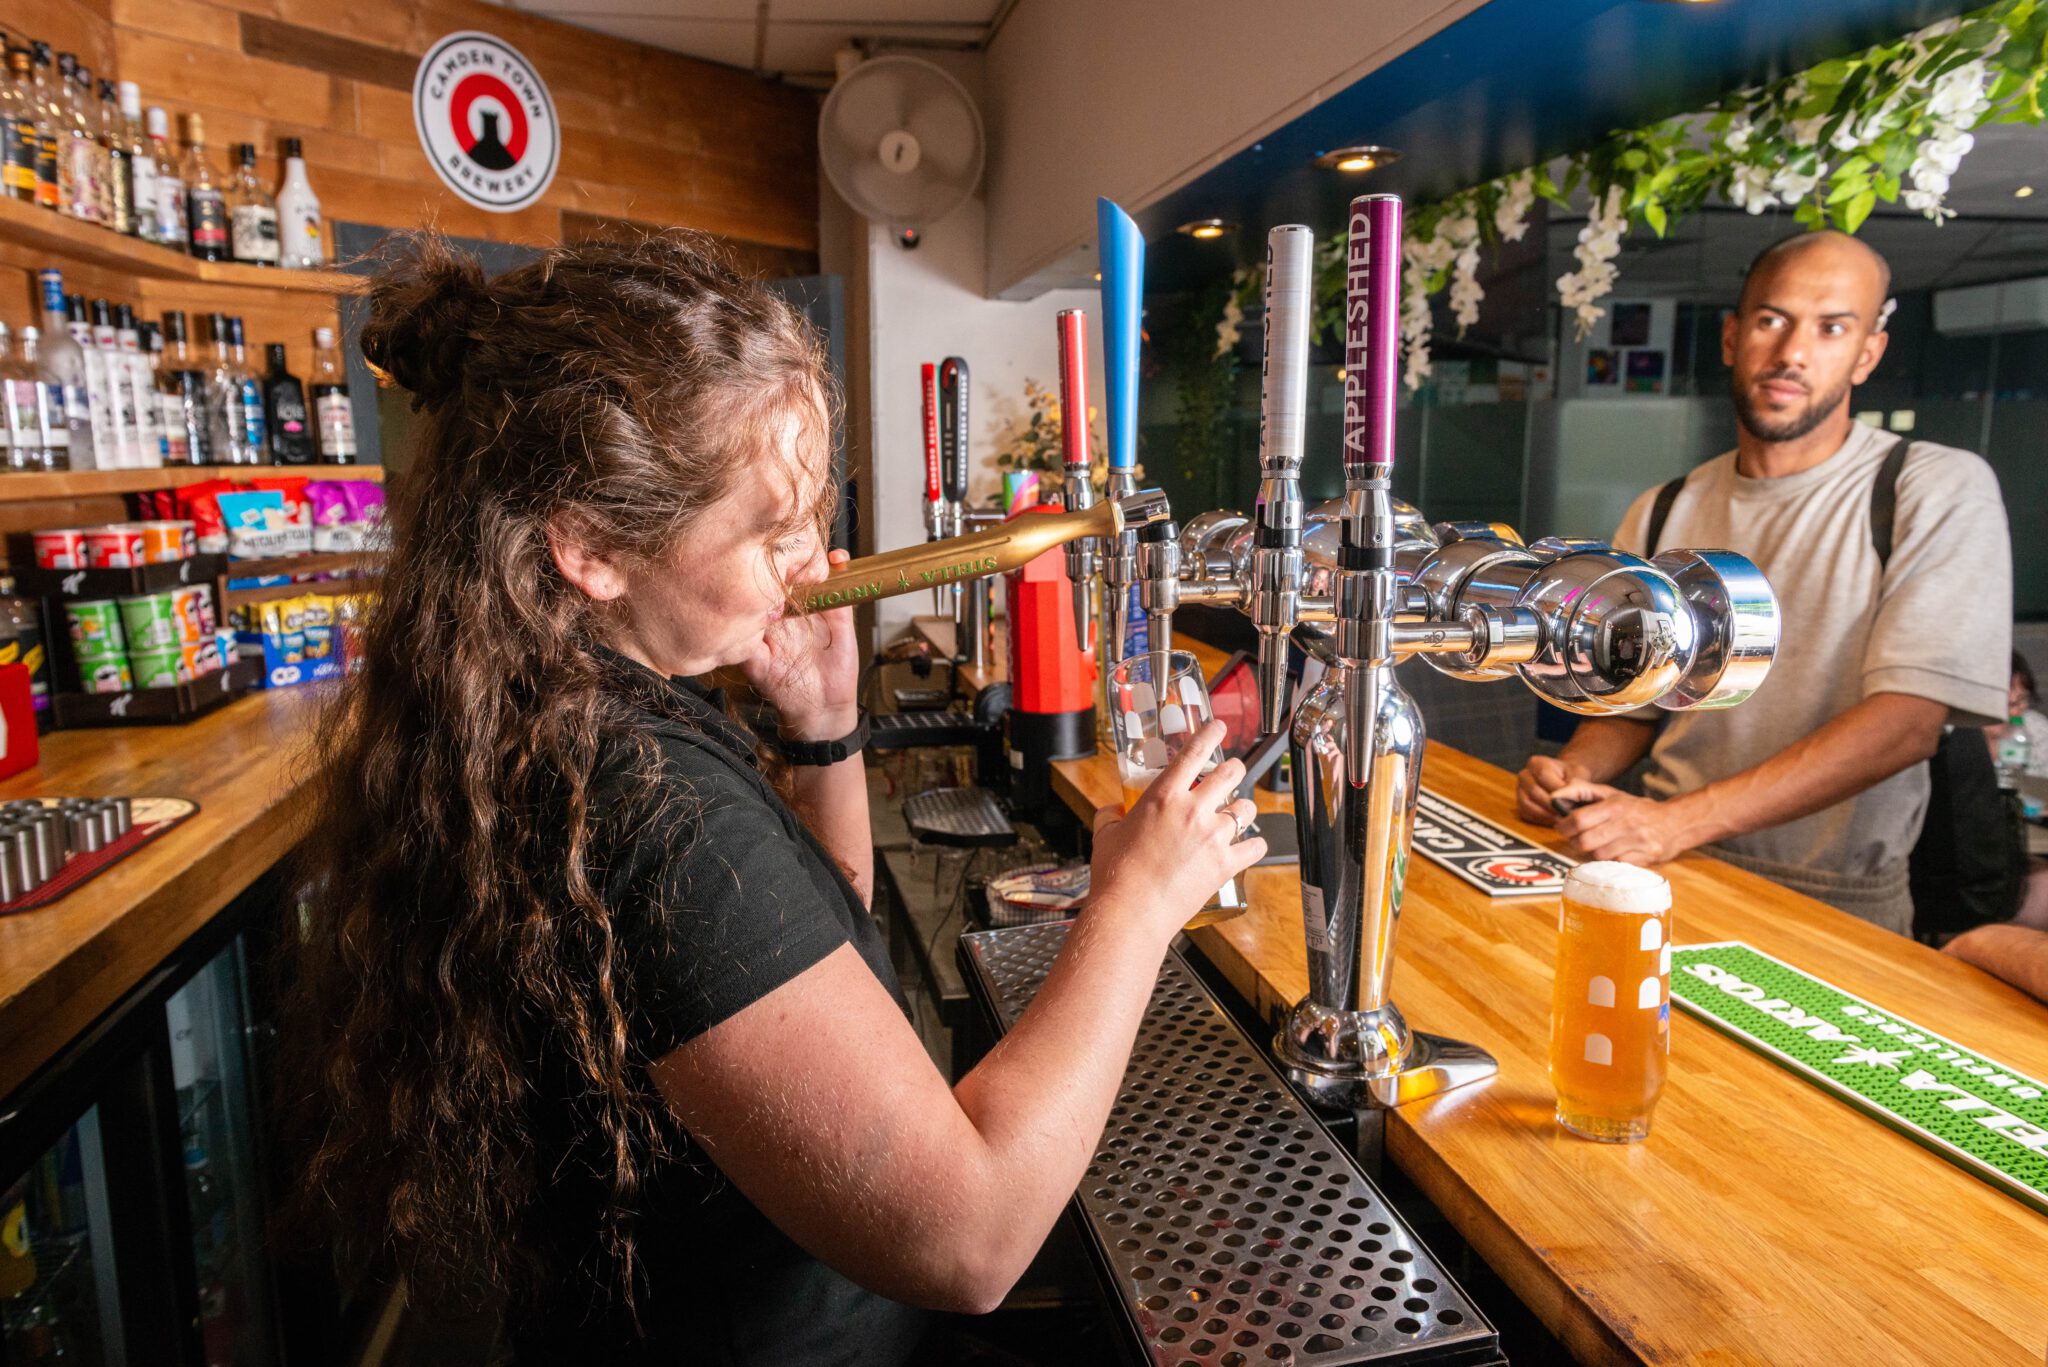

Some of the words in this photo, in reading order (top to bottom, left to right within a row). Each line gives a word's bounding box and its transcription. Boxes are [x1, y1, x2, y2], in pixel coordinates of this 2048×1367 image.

[430, 49, 495, 99] CAMDEN
[503, 62, 543, 118] TOWN
[449, 154, 533, 193] BREWERY
[1345, 212, 1371, 453] APPLESHED
[806, 581, 883, 609] ARTOIS
[920, 556, 998, 583] STELLA
[1682, 962, 1862, 1044] ARTOIS
[1841, 1005, 2043, 1099] UNFILTERED
[1900, 1070, 2048, 1160] ELLA
